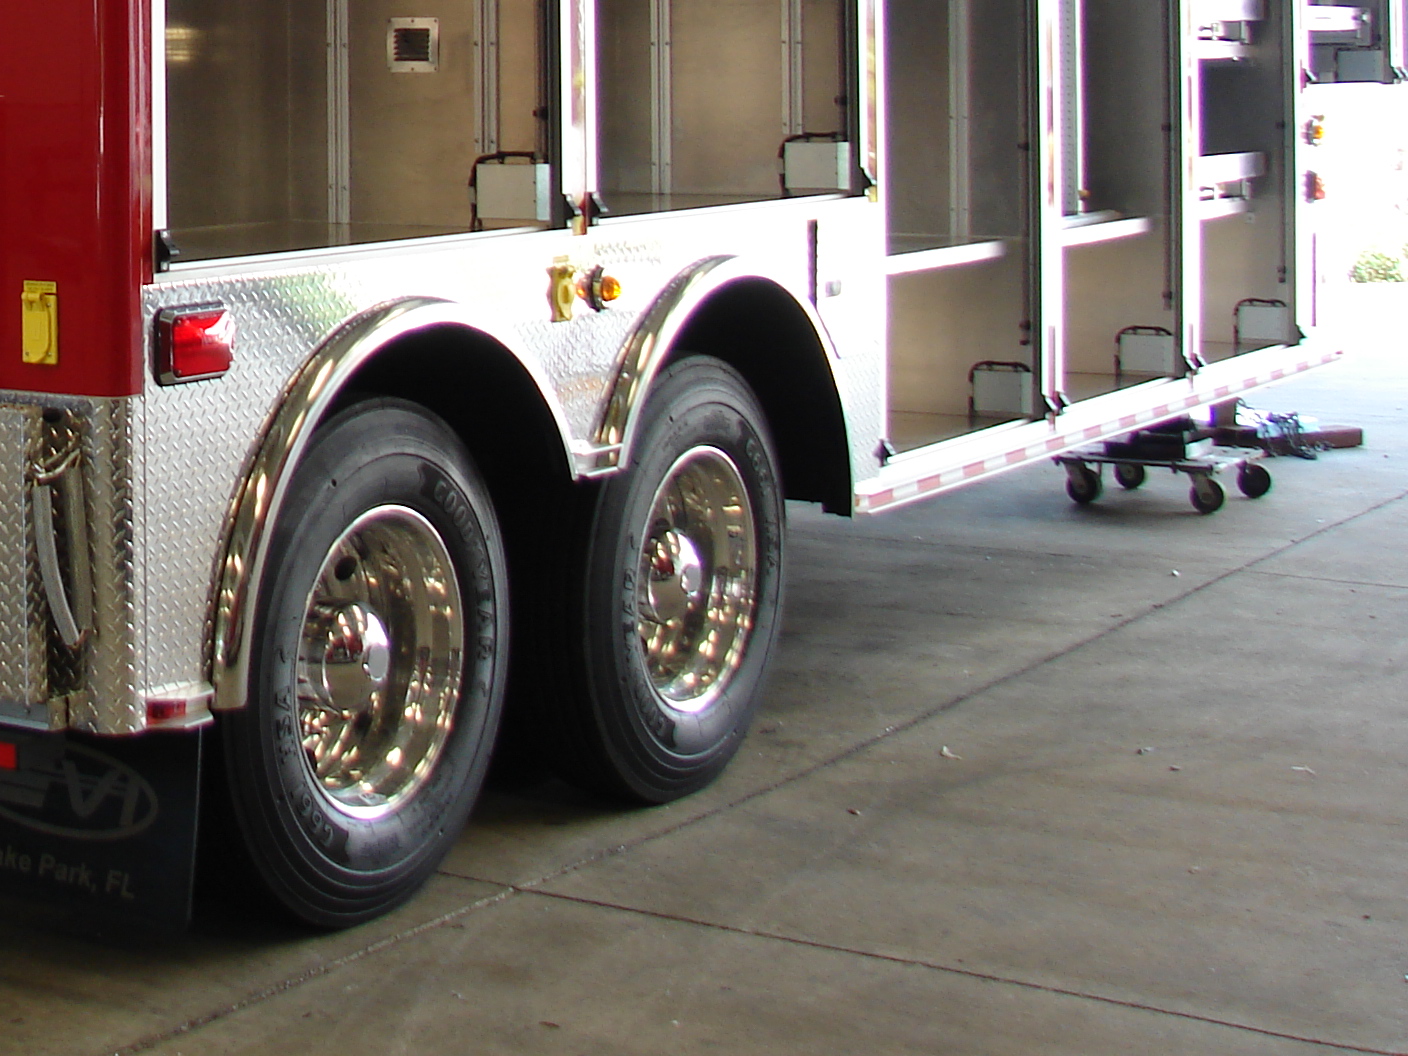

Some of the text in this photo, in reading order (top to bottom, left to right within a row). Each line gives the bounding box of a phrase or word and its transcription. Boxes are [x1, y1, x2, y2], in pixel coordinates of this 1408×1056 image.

[432, 477, 494, 662] GOODYEAR
[38, 853, 97, 893] Park,
[105, 869, 135, 899] FL
